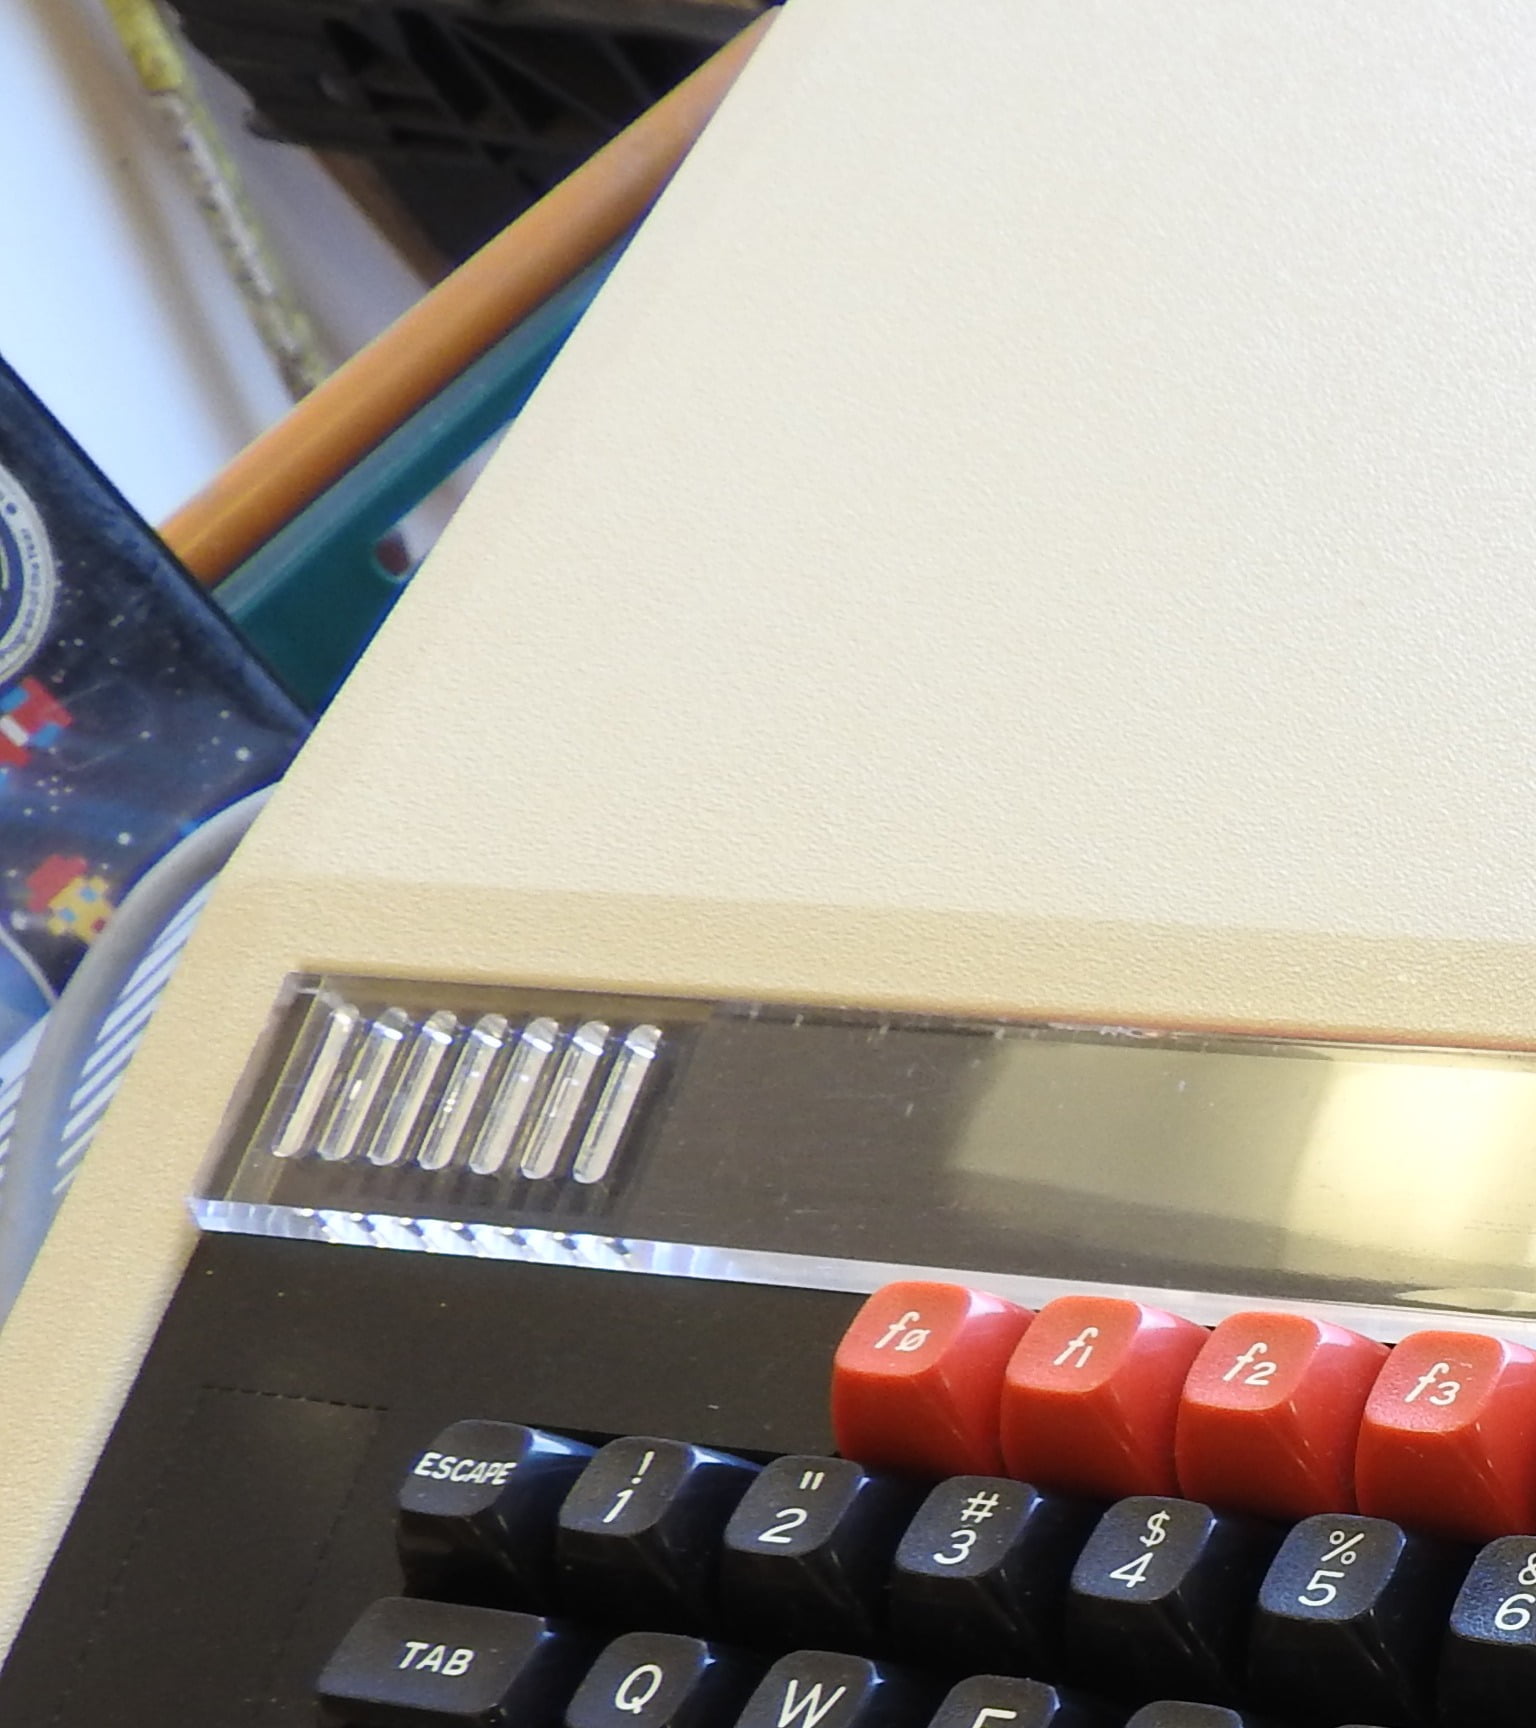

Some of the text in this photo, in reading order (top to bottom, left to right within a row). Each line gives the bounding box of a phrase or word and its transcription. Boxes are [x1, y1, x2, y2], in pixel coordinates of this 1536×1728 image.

[1053, 1328, 1098, 1368] f1
[1222, 1342, 1276, 1386] f2
[1404, 1363, 1460, 1405] f3
[414, 1451, 516, 1486] ESCAPE
[632, 1452, 654, 1484] !
[603, 1490, 633, 1522] 1
[961, 1492, 998, 1523] #
[758, 1509, 807, 1543] 2
[1140, 1511, 1170, 1547] $
[934, 1530, 976, 1564] 3
[1325, 1531, 1364, 1564] %
[1111, 1554, 1147, 1588] 4
[1298, 1570, 1344, 1606] 5
[1495, 1594, 1536, 1630] 6
[400, 1642, 473, 1675] TAB
[615, 1665, 662, 1713] Q
